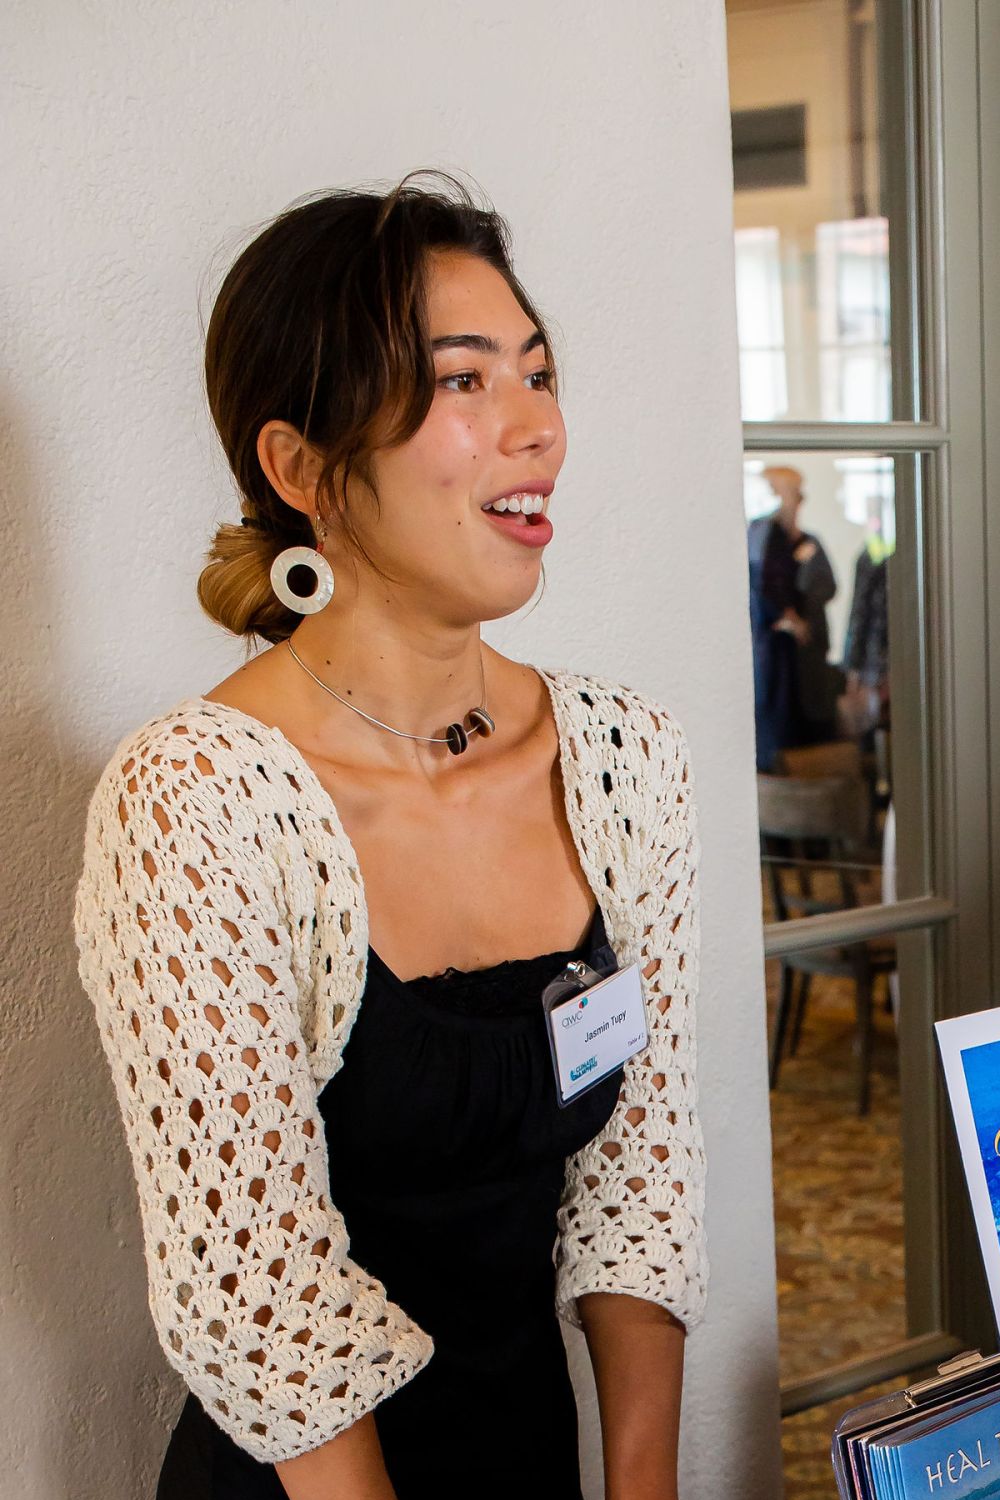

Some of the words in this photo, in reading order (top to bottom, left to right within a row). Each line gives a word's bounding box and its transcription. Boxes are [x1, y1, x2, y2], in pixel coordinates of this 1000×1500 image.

[584, 1019, 610, 1043] Jasmin
[610, 1009, 627, 1029] Tupy
[926, 1440, 991, 1493] HEAL
